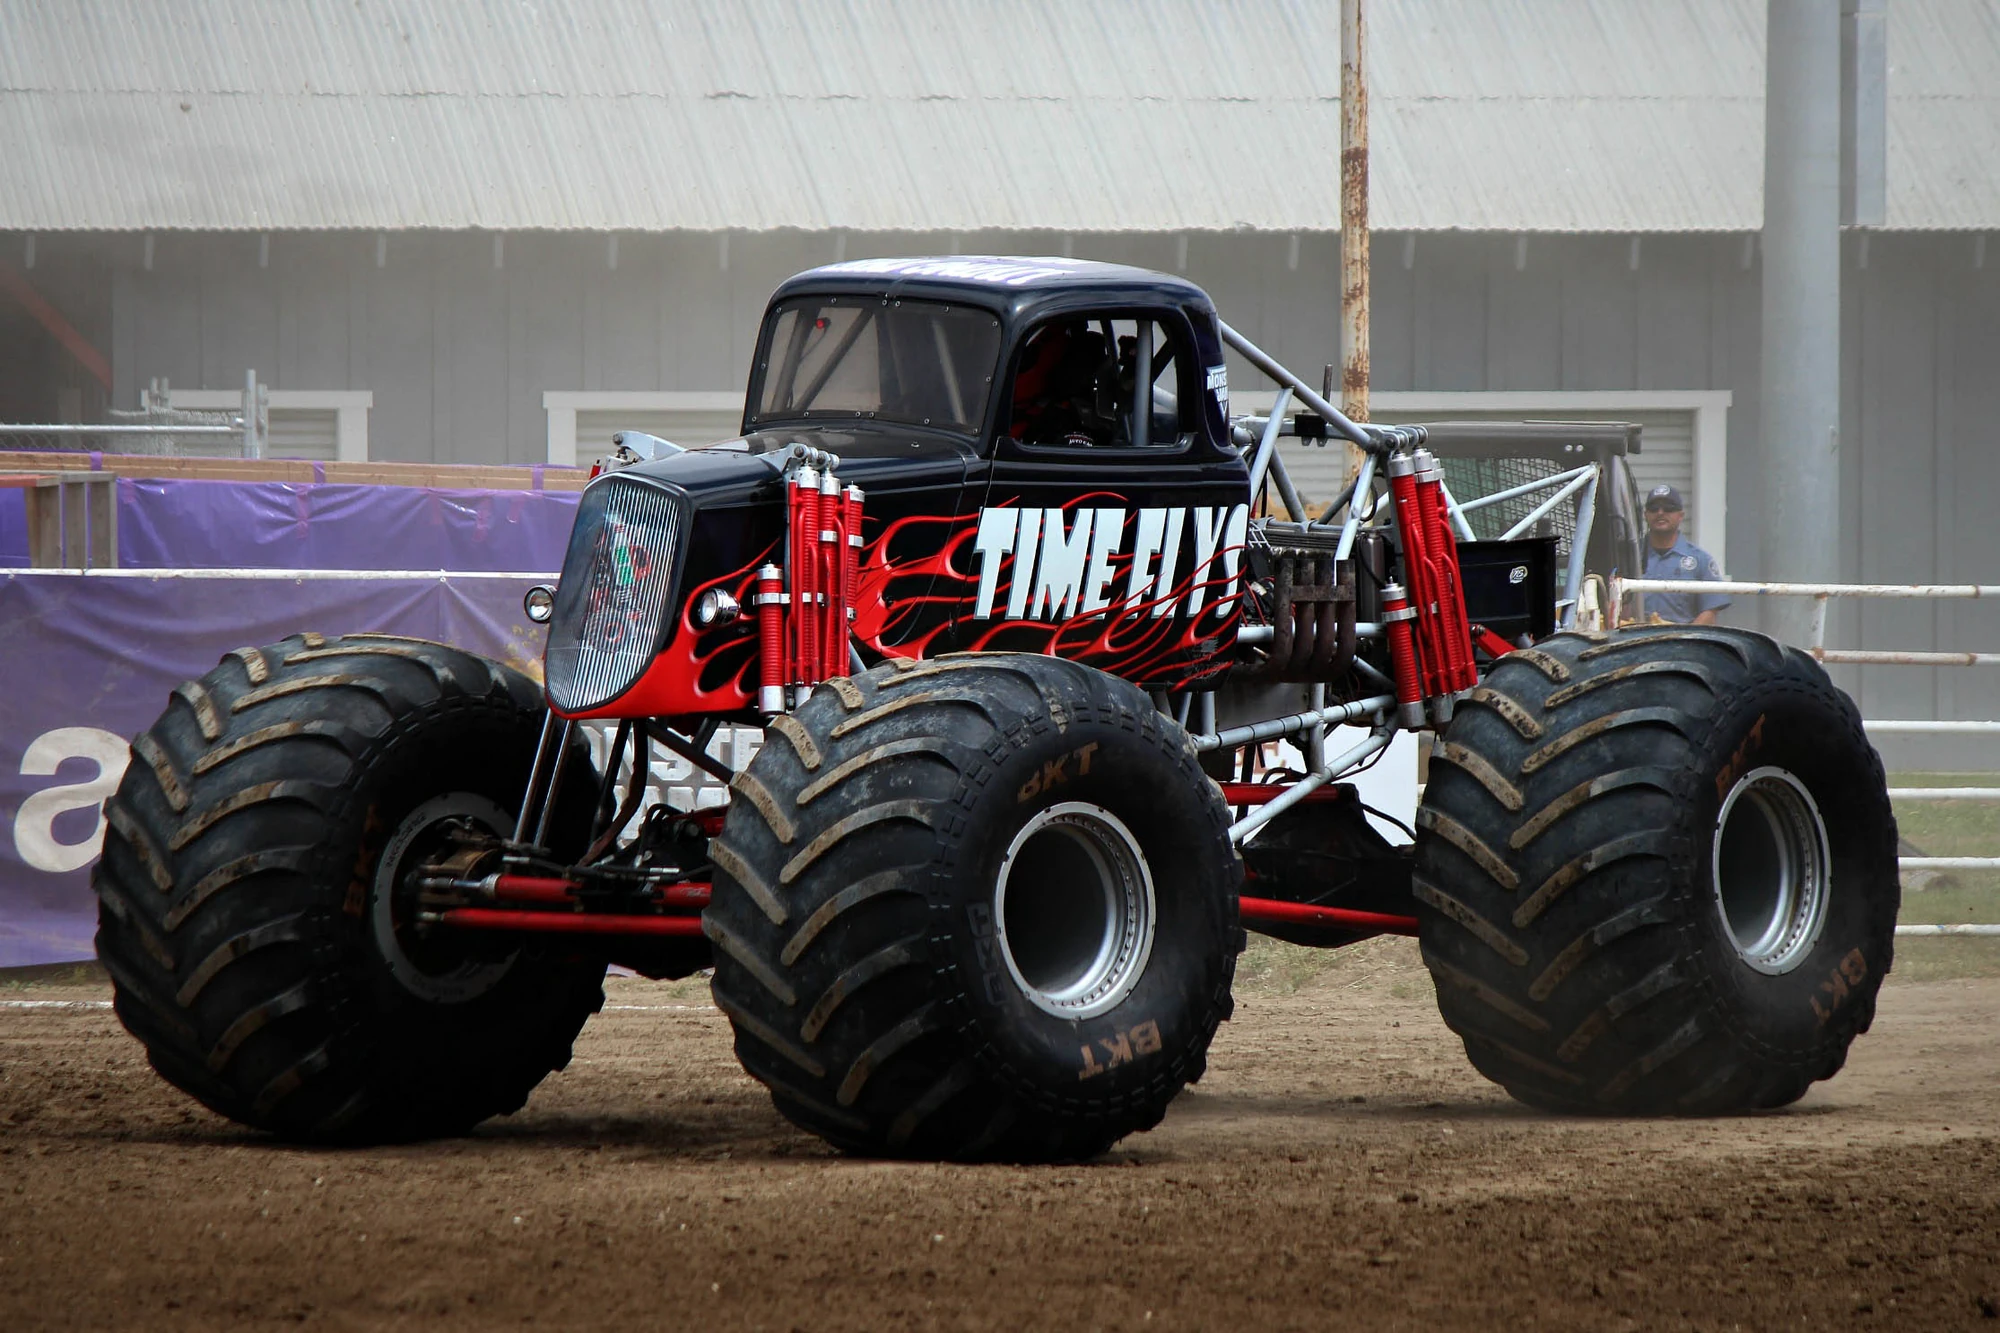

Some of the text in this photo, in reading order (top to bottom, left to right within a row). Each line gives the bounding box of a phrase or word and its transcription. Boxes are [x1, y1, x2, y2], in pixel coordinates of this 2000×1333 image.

[973, 503, 1249, 620] TIME FLYS
[1017, 742, 1099, 803] BKT
[1078, 1018, 1162, 1081] BKT
